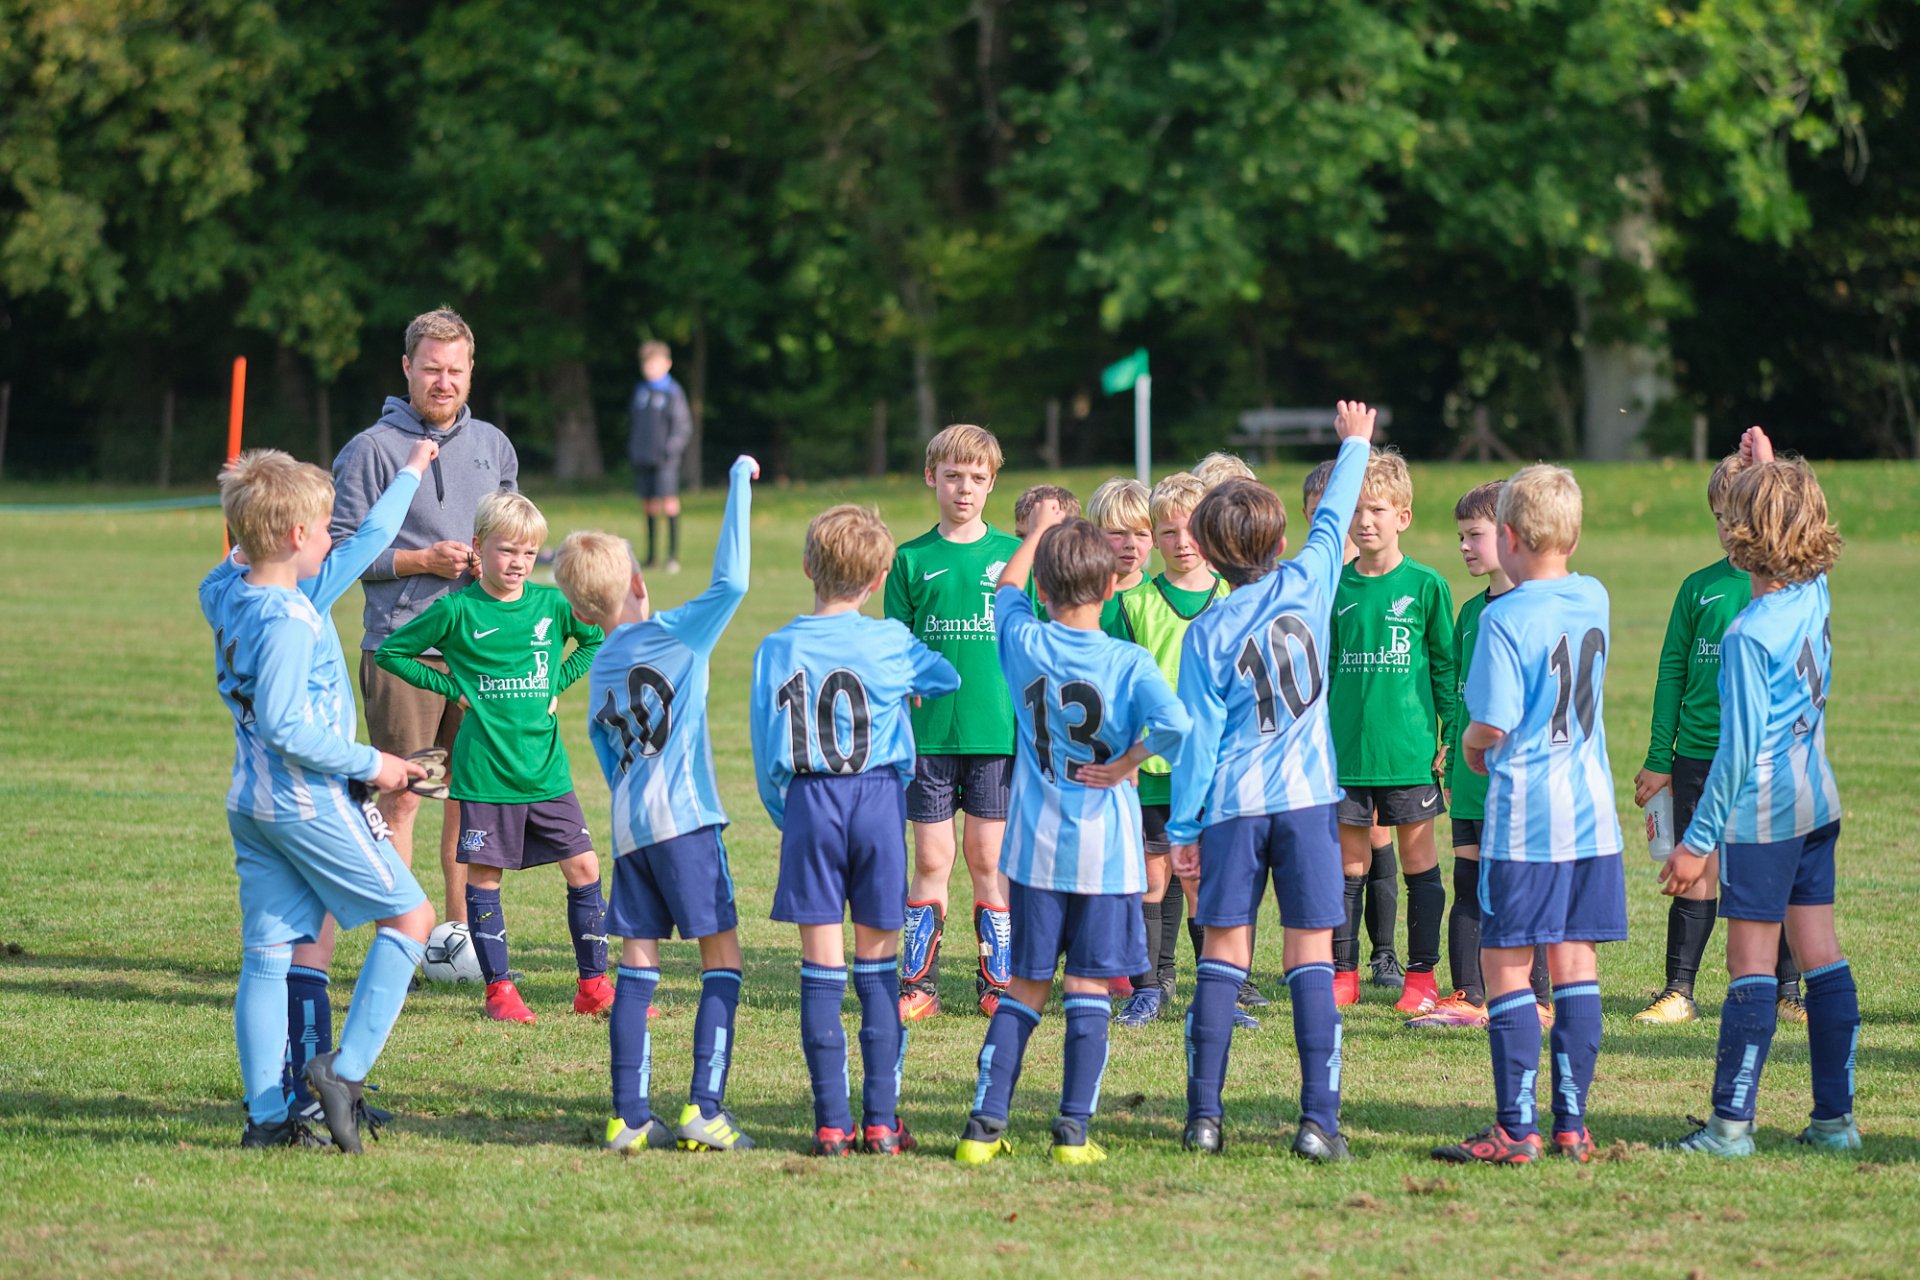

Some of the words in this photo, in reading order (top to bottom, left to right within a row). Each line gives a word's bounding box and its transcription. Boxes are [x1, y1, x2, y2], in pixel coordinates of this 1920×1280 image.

[532, 650, 549, 678] B
[924, 613, 996, 632] Bramdea
[1235, 612, 1323, 735] 10
[1387, 626, 1411, 653] B
[594, 663, 677, 776] 10
[777, 667, 872, 774] 10
[1023, 674, 1114, 785] 13
[1549, 627, 1606, 746] 10
